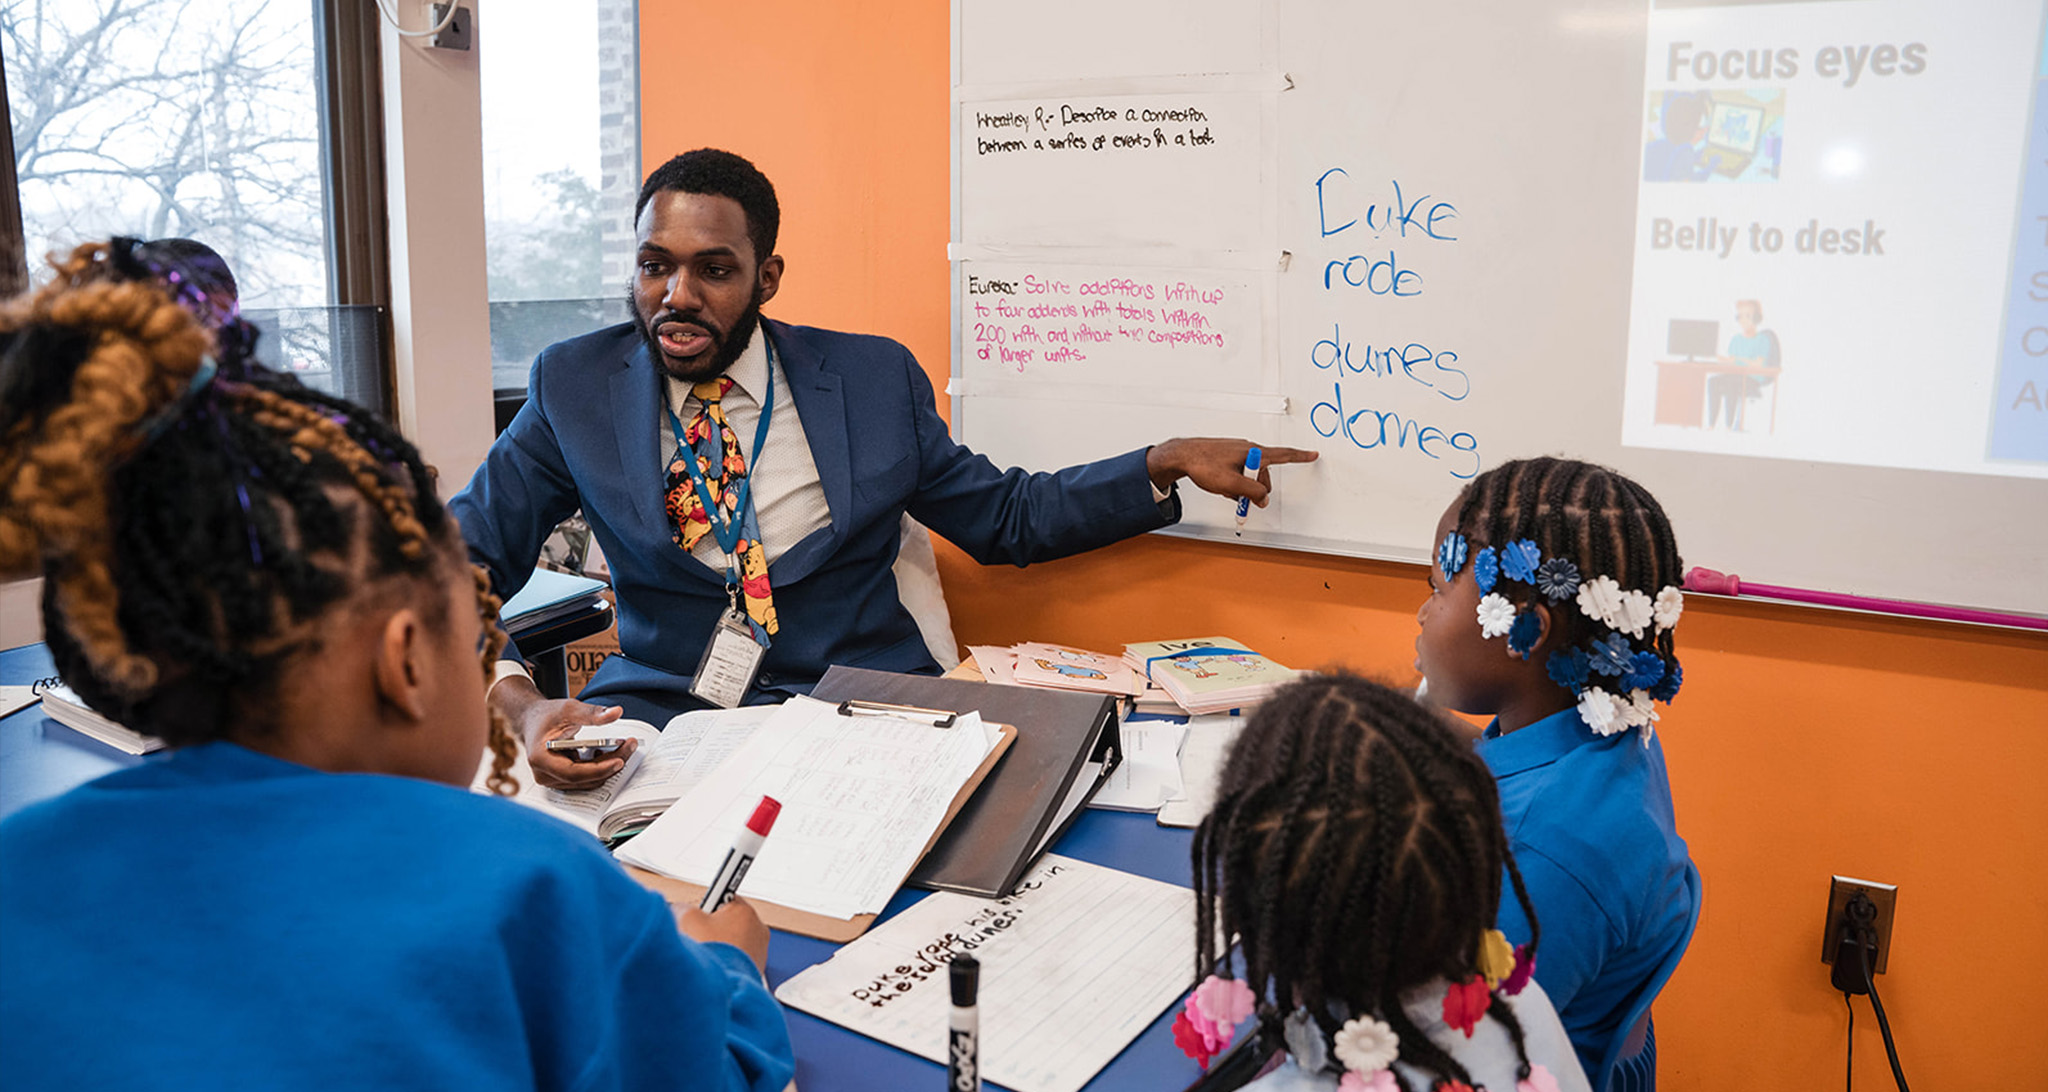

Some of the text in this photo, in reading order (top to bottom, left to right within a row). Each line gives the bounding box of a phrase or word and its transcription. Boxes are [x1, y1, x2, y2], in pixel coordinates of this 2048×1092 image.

[1666, 40, 1928, 88] Focus eyes
[1125, 108, 1139, 122] a
[1033, 139, 1045, 150] a
[1174, 134, 1187, 147] a
[1651, 217, 1886, 259] Belly to desk
[1023, 273, 1071, 295] Solve
[1324, 250, 1424, 297] rode
[974, 301, 991, 319] to
[974, 322, 1007, 345] 200
[976, 343, 994, 361] of
